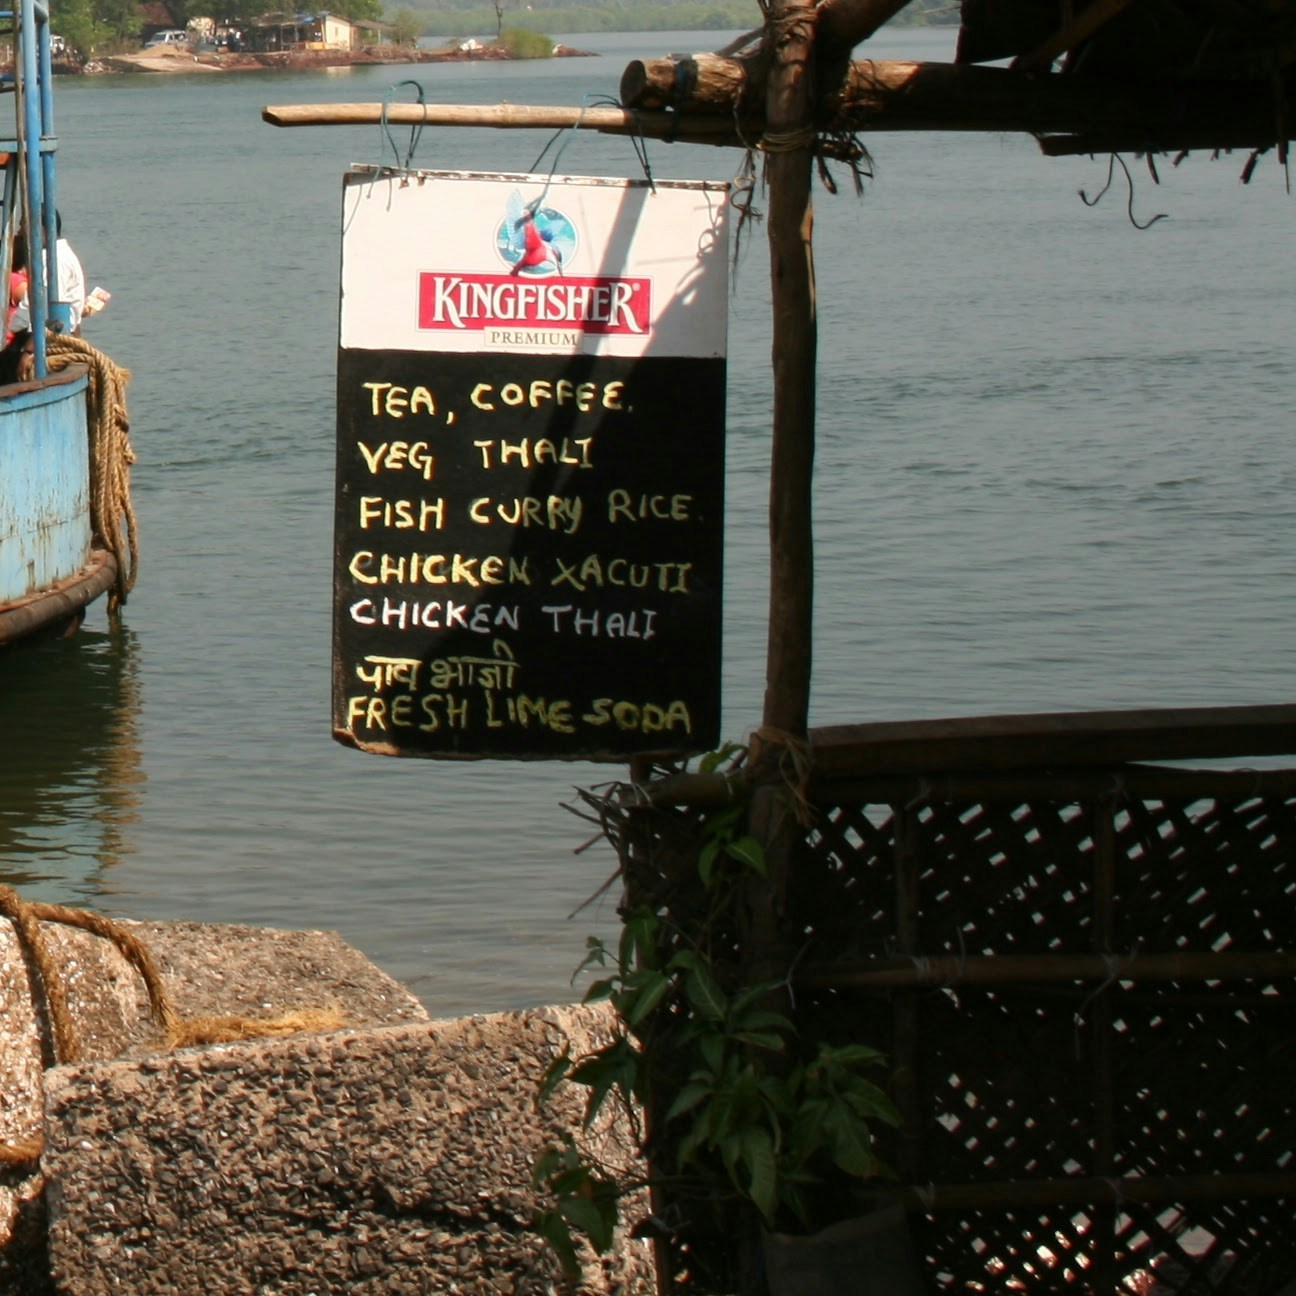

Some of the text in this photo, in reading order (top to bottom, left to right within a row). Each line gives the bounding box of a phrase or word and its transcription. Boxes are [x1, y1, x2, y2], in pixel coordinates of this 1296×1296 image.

[432, 276, 644, 334] KINGFISHER
[491, 330, 578, 346] PREMIUM
[362, 382, 455, 425] TEA,
[357, 438, 594, 480] VEG THALI
[359, 497, 444, 532] FISH
[469, 495, 583, 534] CURRY
[348, 551, 693, 593] CHICKEN XACUTI
[349, 597, 658, 641] CHICKEN THALI
[346, 690, 693, 735] FRESH LIME SODA
